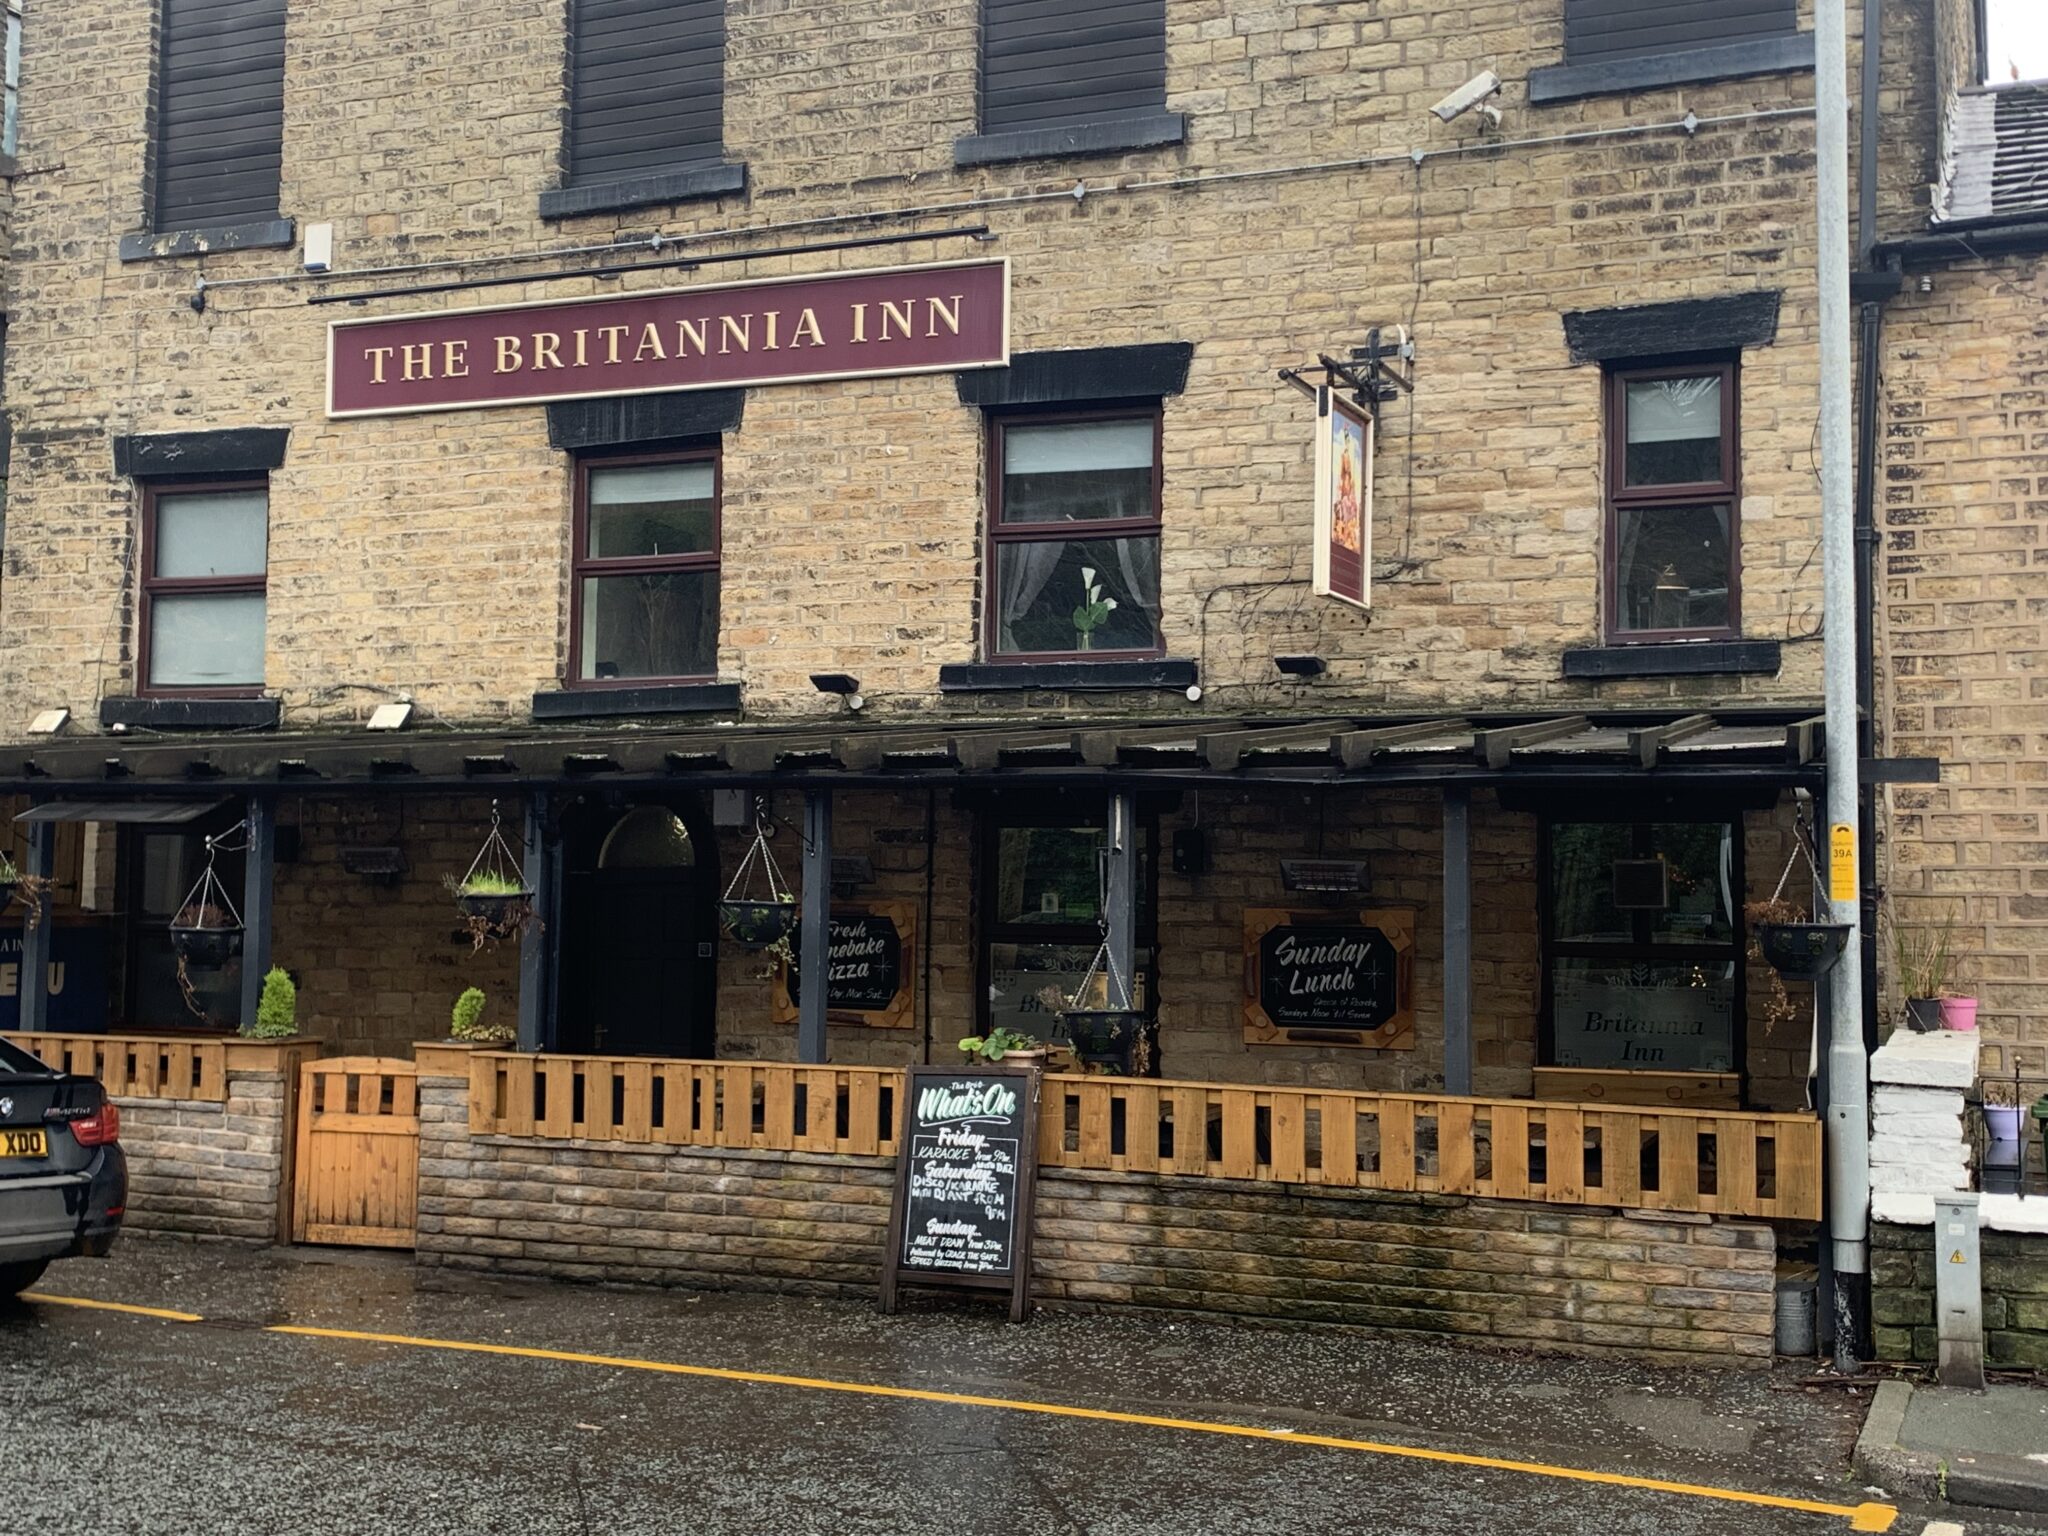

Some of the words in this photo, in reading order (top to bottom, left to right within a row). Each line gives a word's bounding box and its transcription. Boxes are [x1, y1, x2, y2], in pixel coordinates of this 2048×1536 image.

[364, 340, 469, 384] THE
[492, 307, 826, 374] BRITANNIA
[849, 295, 964, 343] INN
[828, 937, 885, 959] nebake
[1275, 936, 1371, 969] Sunday
[828, 962, 870, 981] izza
[1290, 966, 1355, 995] Lunch
[1622, 1039, 1665, 1061] Inn
[918, 1087, 984, 1120] What's
[983, 1084, 1016, 1115] On
[918, 1146, 971, 1160] KARAOKE
[914, 1235, 938, 1246] MEAT
[940, 1237, 965, 1249] DRAW
